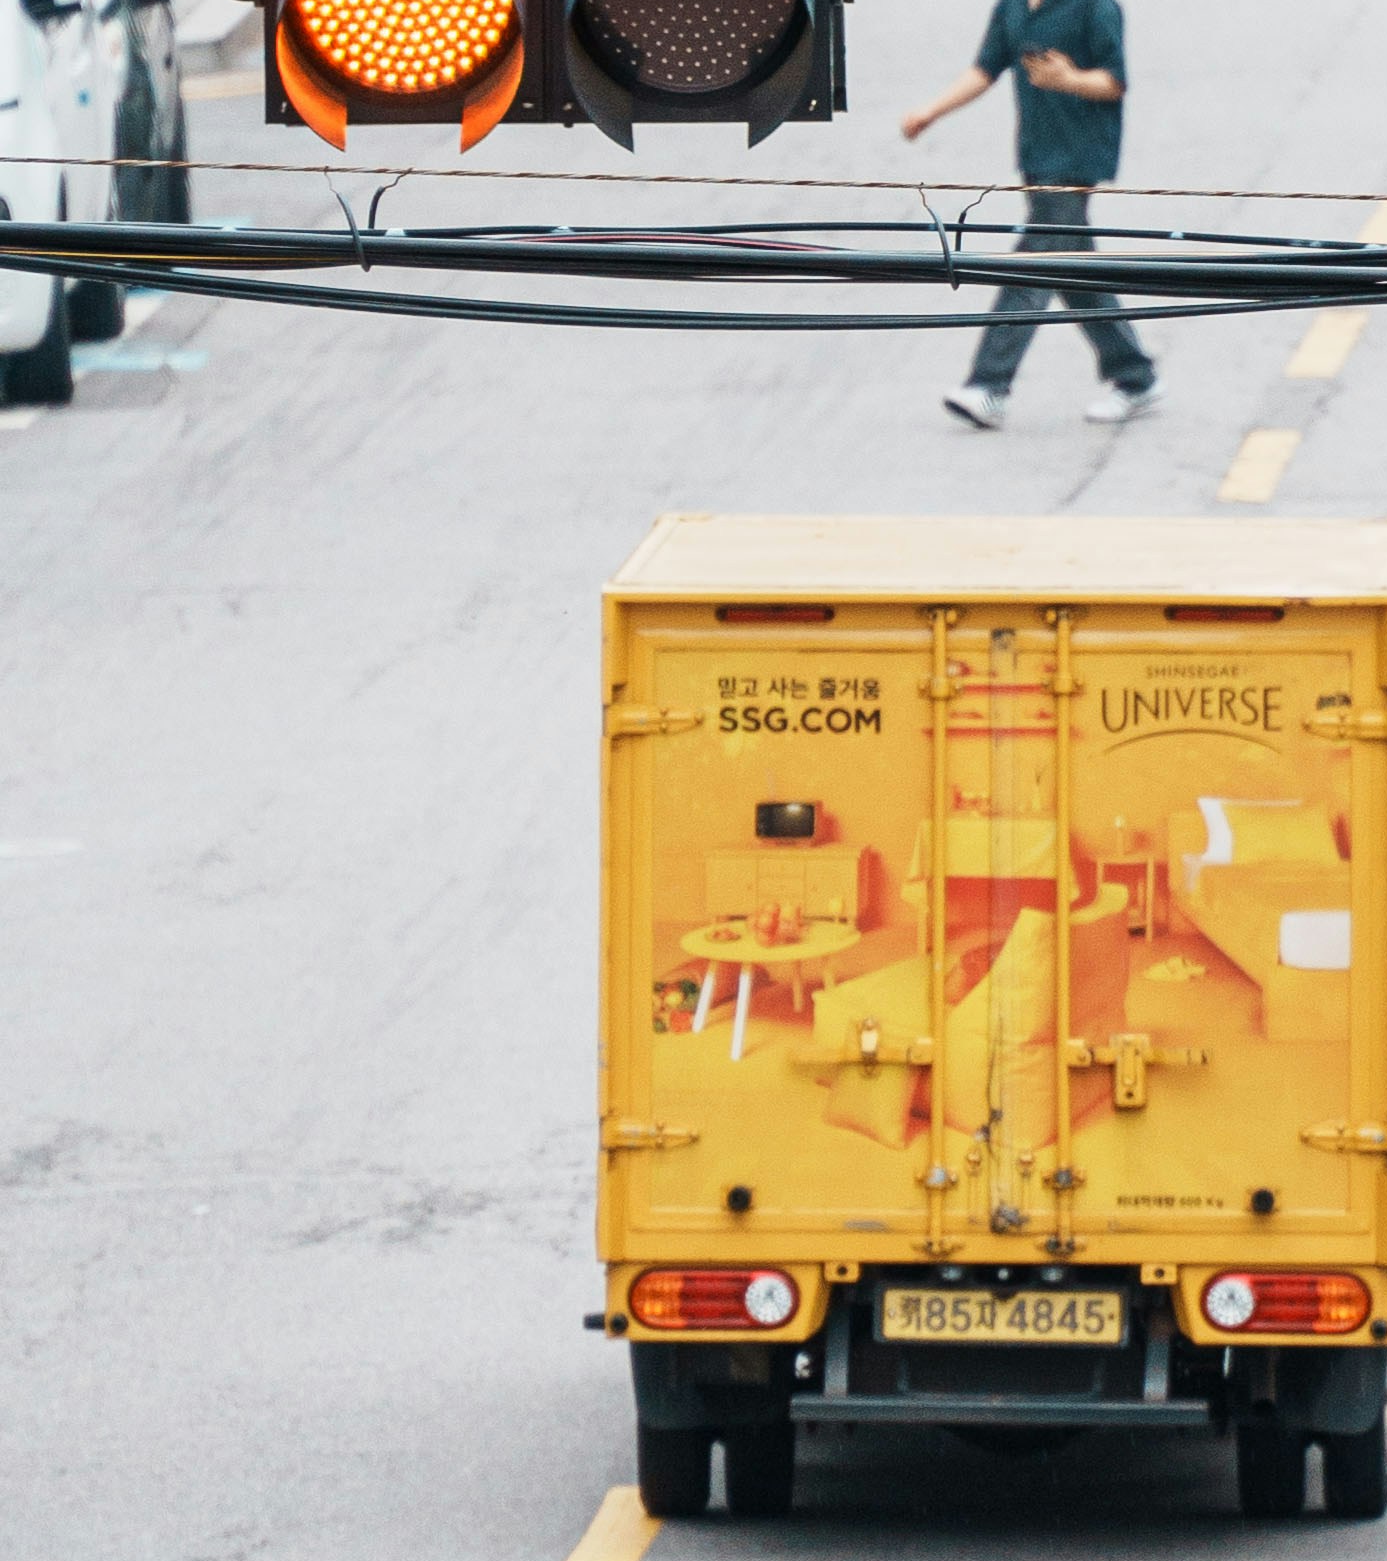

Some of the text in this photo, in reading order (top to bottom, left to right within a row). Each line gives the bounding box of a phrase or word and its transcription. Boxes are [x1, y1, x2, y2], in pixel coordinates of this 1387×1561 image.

[1146, 664, 1241, 679] SHINSEGAE
[718, 676, 881, 701] 믿고 사는 즐거움
[719, 706, 882, 735] SSG.COM
[1101, 685, 1283, 733] UNIVERSE
[1007, 1297, 1105, 1334] 4845
